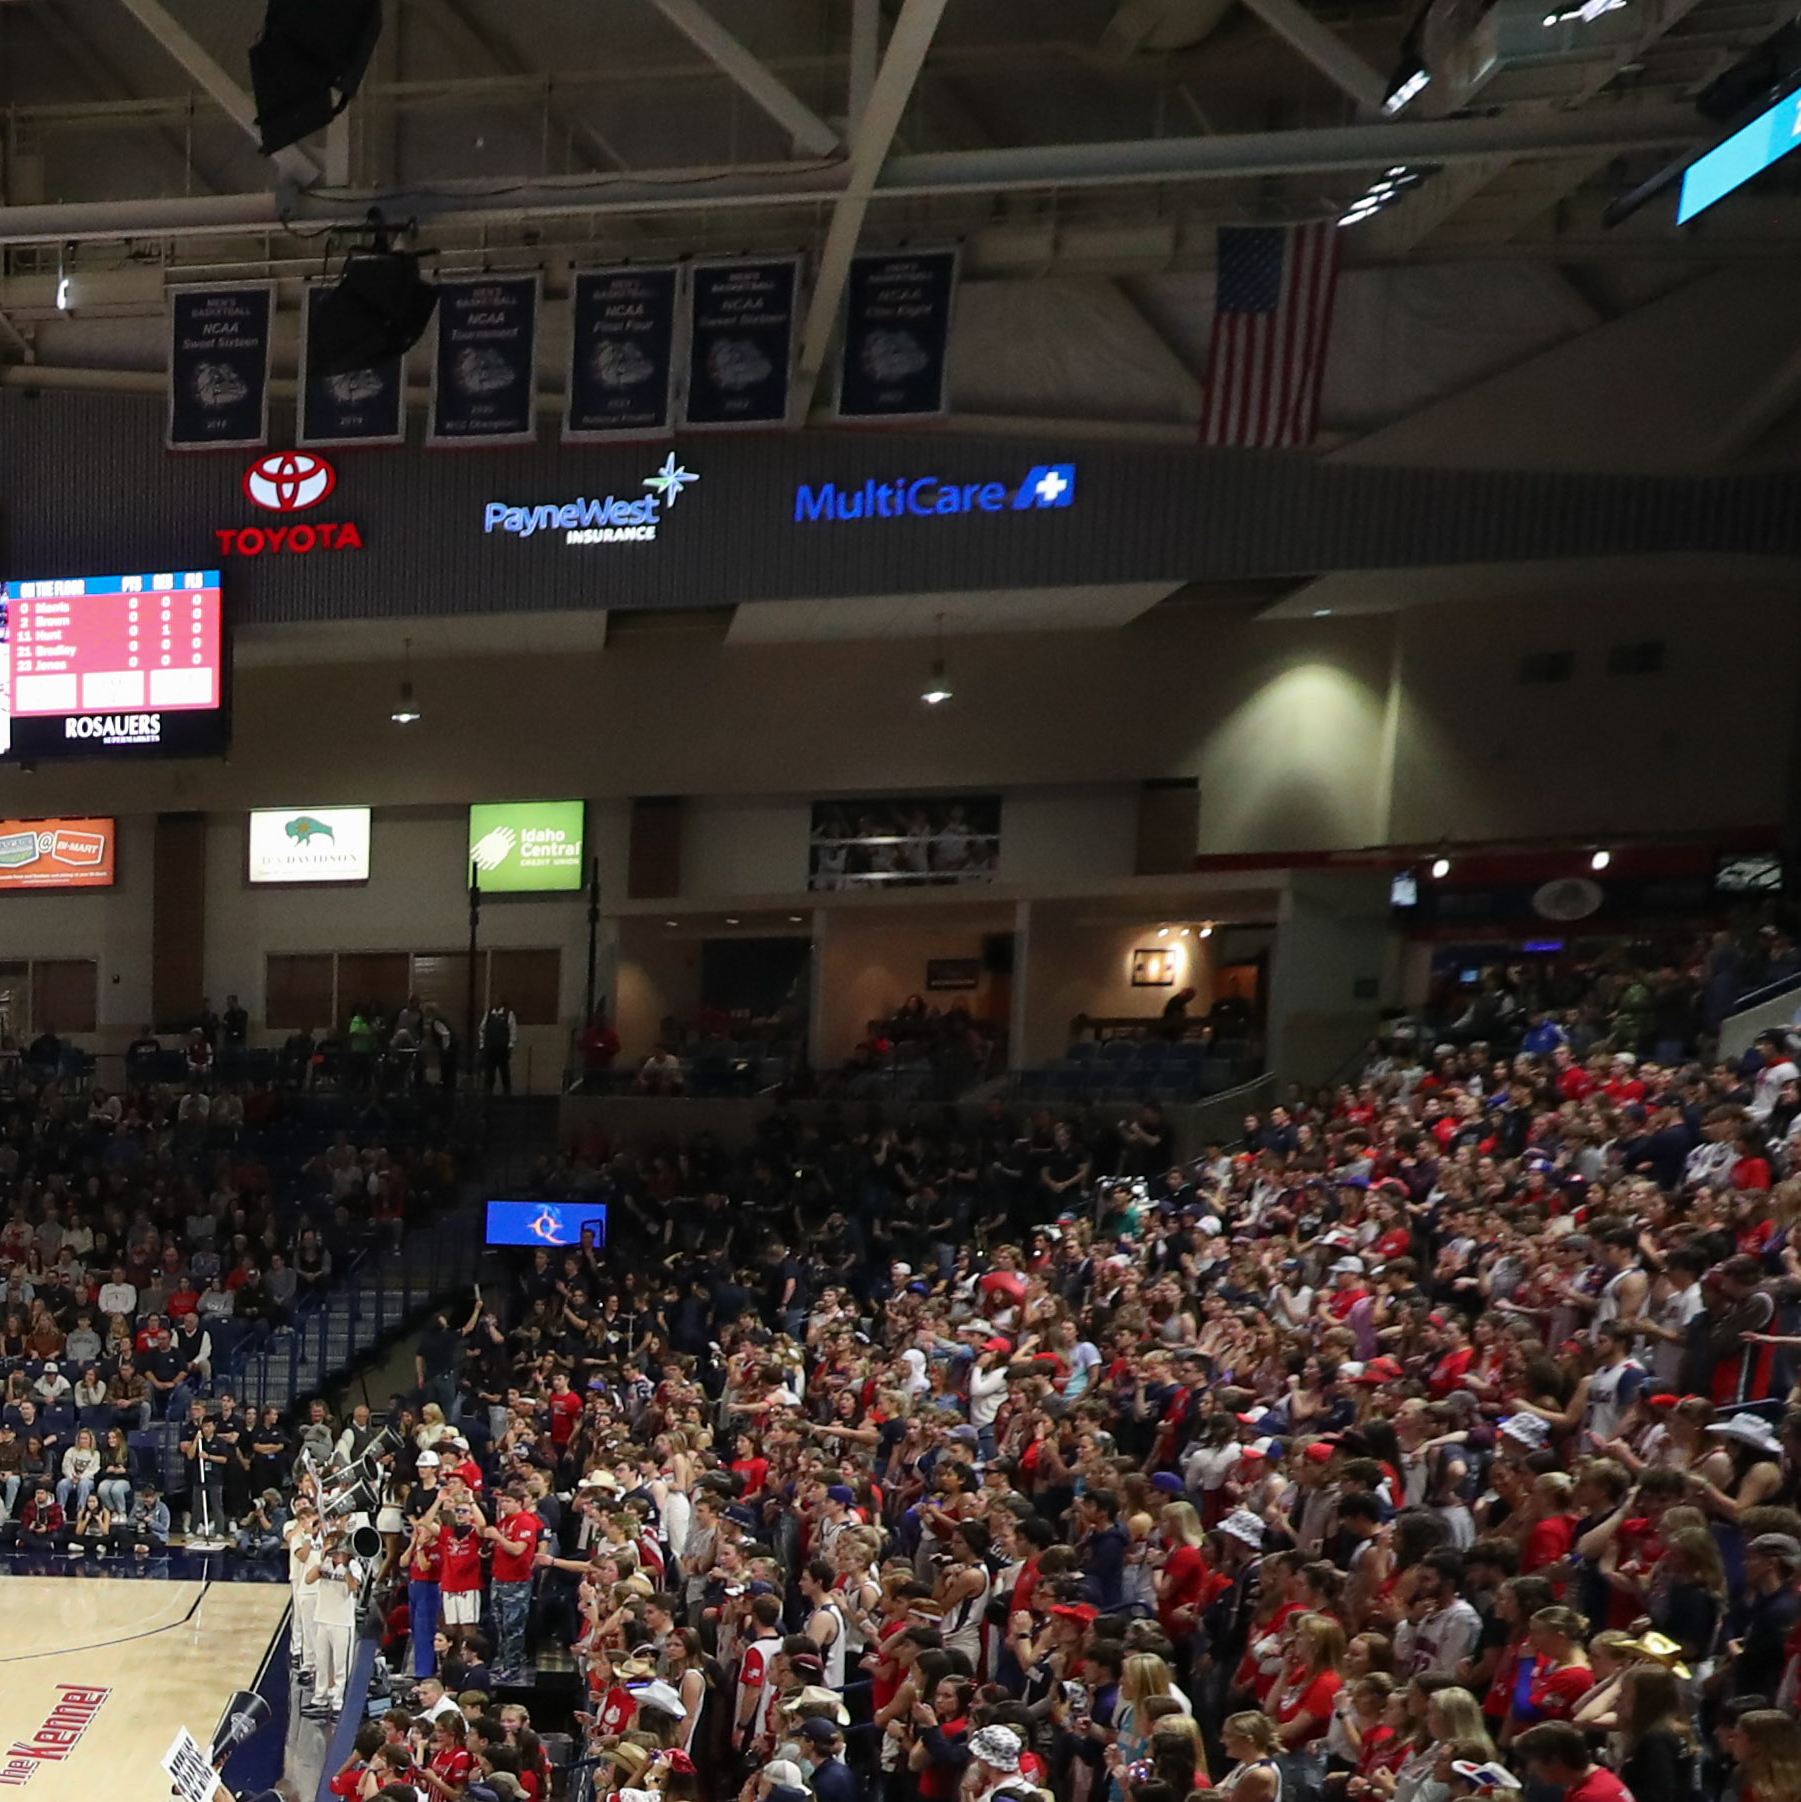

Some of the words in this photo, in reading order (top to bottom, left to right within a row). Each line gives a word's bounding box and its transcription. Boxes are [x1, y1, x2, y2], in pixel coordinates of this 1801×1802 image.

[467, 312, 505, 326] NCAA
[604, 303, 646, 318] NCAA
[202, 322, 240, 335] NCAA
[793, 475, 1008, 523] MultiCare
[483, 493, 661, 538] PayneWest
[215, 521, 365, 557] TOYOTA
[565, 525, 658, 546] INSURANCE
[64, 714, 162, 739] ROSAUERS
[39, 831, 54, 854] @
[521, 828, 566, 843] Idaho
[286, 853, 358, 865] DAVIDSON
[520, 841, 582, 858] Central
[520, 858, 552, 868] CREDIT
[552, 857, 581, 867] UNION
[6, 1683, 114, 1763] Kennel
